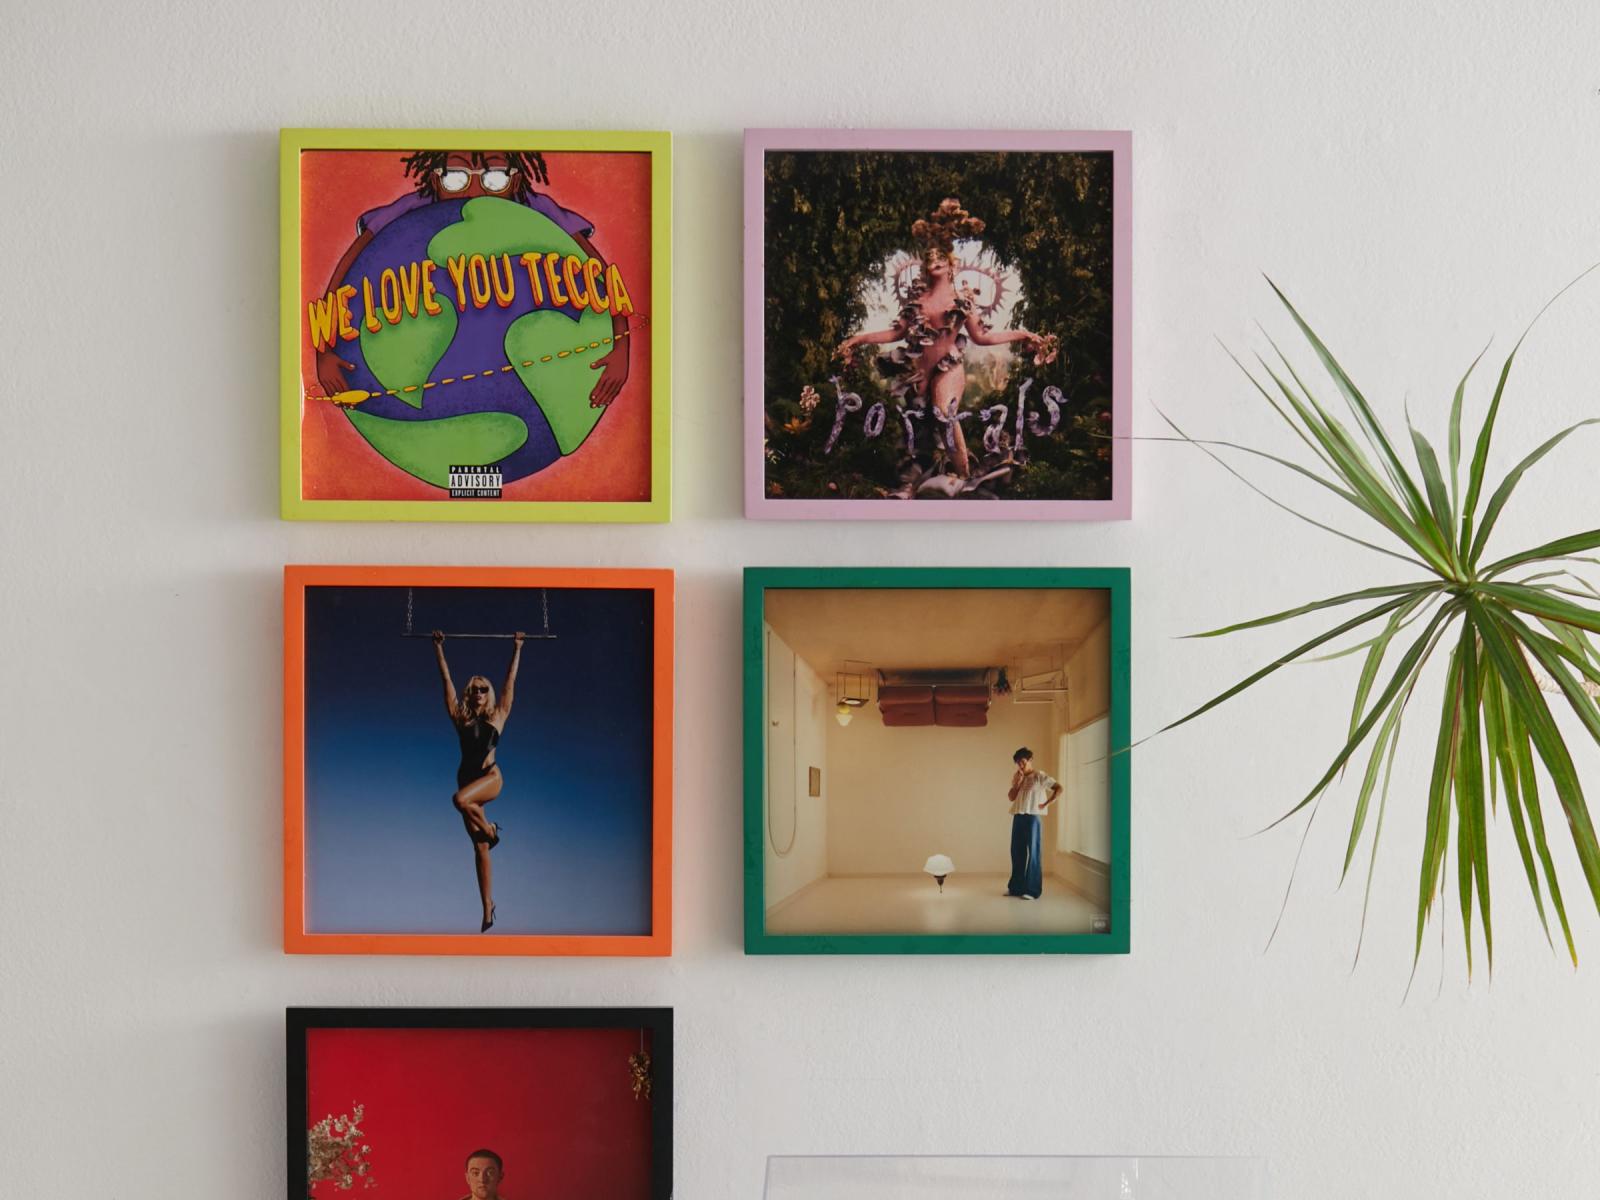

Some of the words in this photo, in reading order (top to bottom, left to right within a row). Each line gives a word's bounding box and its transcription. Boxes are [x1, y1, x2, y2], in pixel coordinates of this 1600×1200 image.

[308, 284, 360, 353] WE
[362, 259, 443, 334] LOVE
[447, 253, 515, 312] YOU
[519, 252, 634, 317] TECCA
[450, 475, 500, 487] ADVISORY
[451, 489, 475, 497] EXPLICIT
[477, 489, 500, 497] CONTENT
